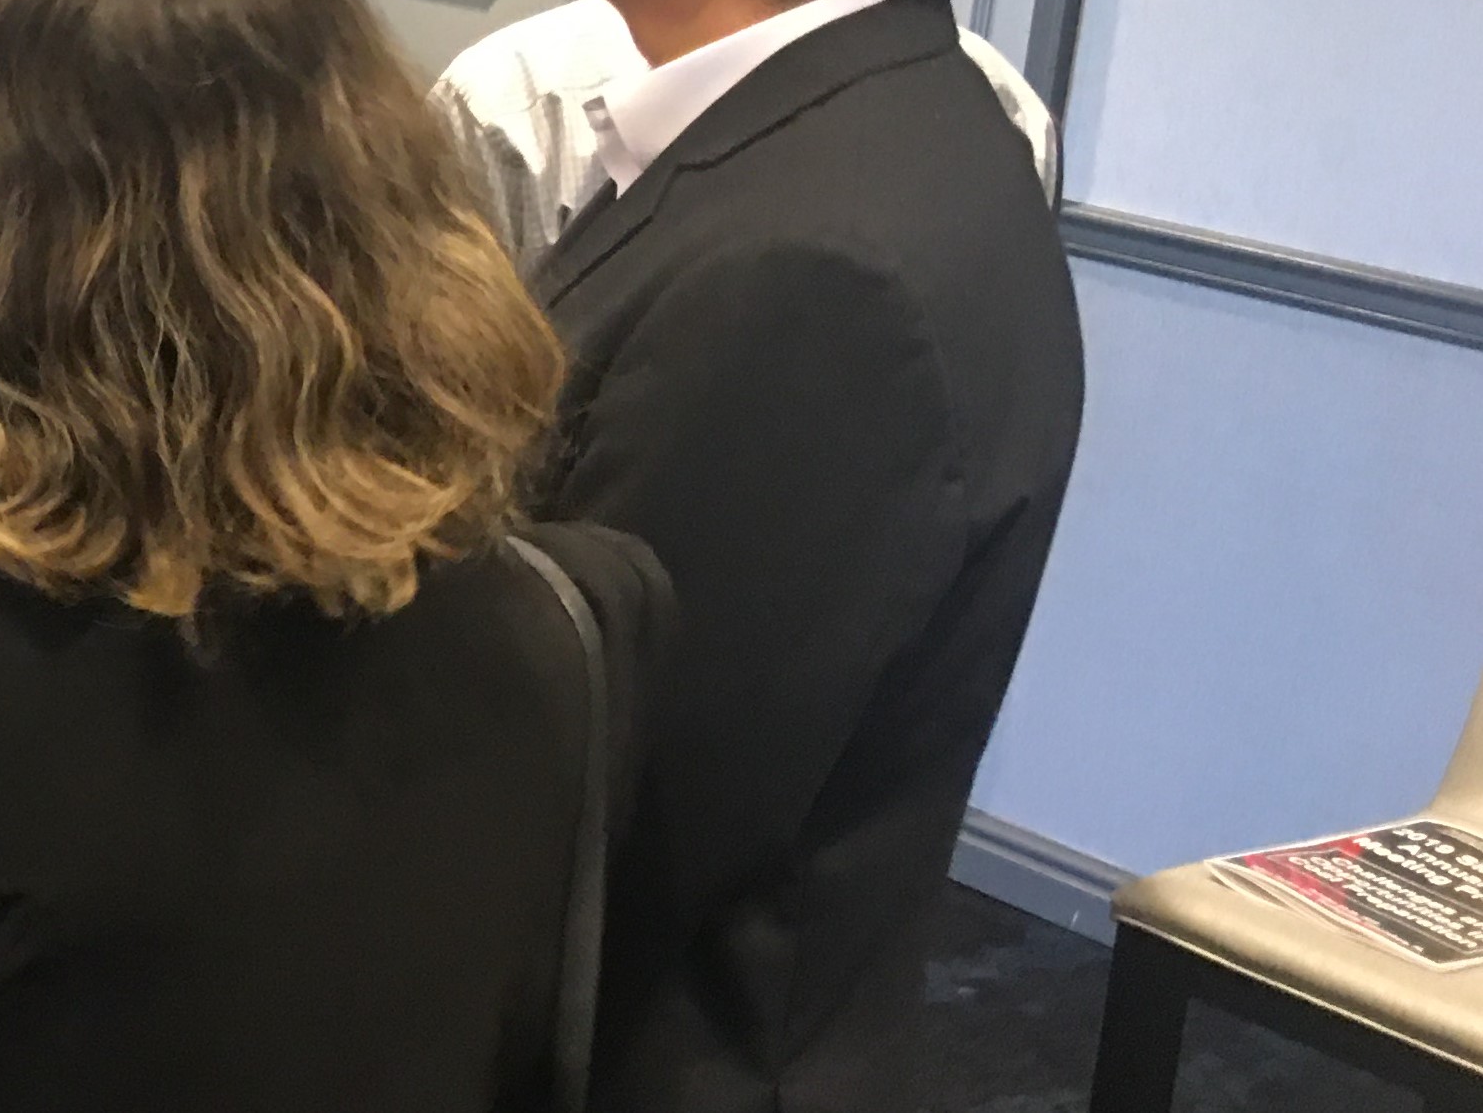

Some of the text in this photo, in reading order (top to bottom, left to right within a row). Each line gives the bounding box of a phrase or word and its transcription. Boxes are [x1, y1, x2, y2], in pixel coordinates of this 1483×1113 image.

[1353, 837, 1452, 885] Meeting
[1393, 828, 1455, 854] 2019
[1288, 856, 1344, 882] Coal
[1342, 883, 1477, 948] Preparation
[1310, 856, 1464, 930] Opportunities
[1332, 857, 1457, 915] Challenges
